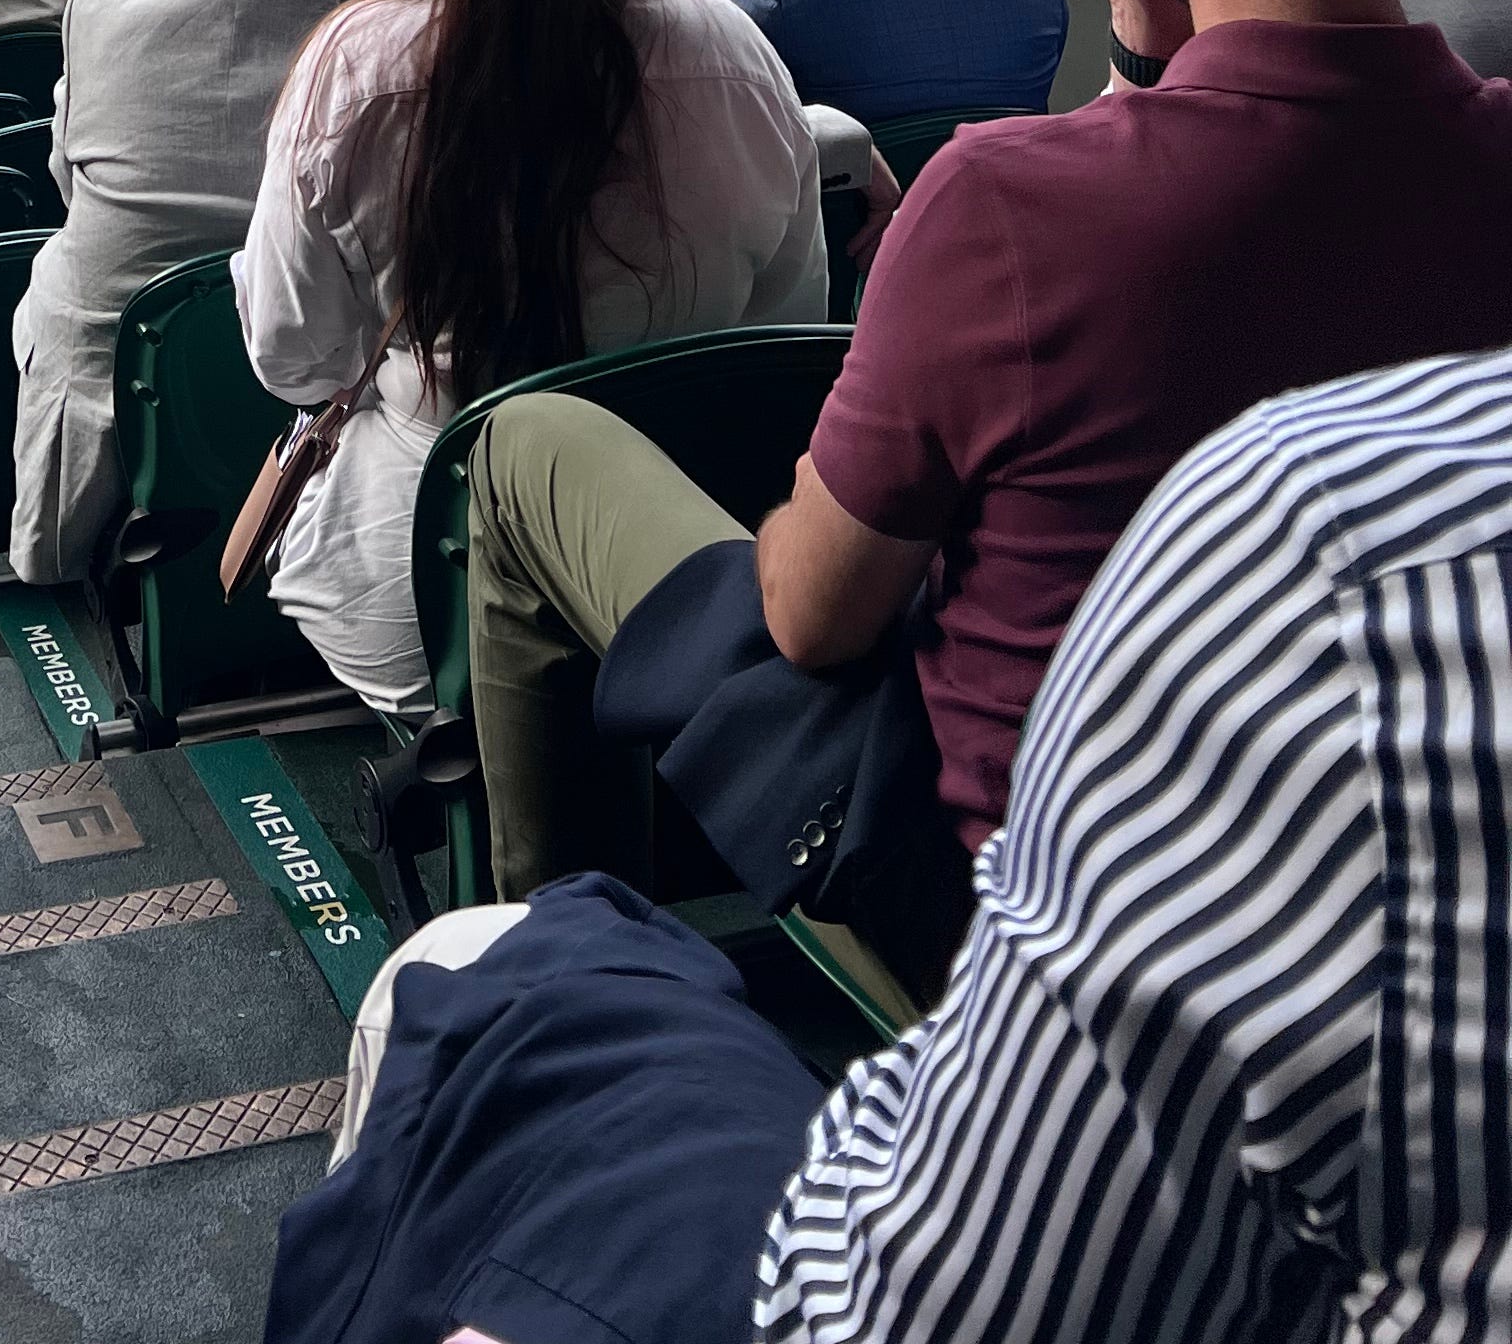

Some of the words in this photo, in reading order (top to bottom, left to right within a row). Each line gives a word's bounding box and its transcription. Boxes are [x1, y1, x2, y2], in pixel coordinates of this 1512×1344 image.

[21, 624, 100, 727] MEMBERS
[37, 804, 118, 839] F
[240, 793, 361, 945] MEMBERS
